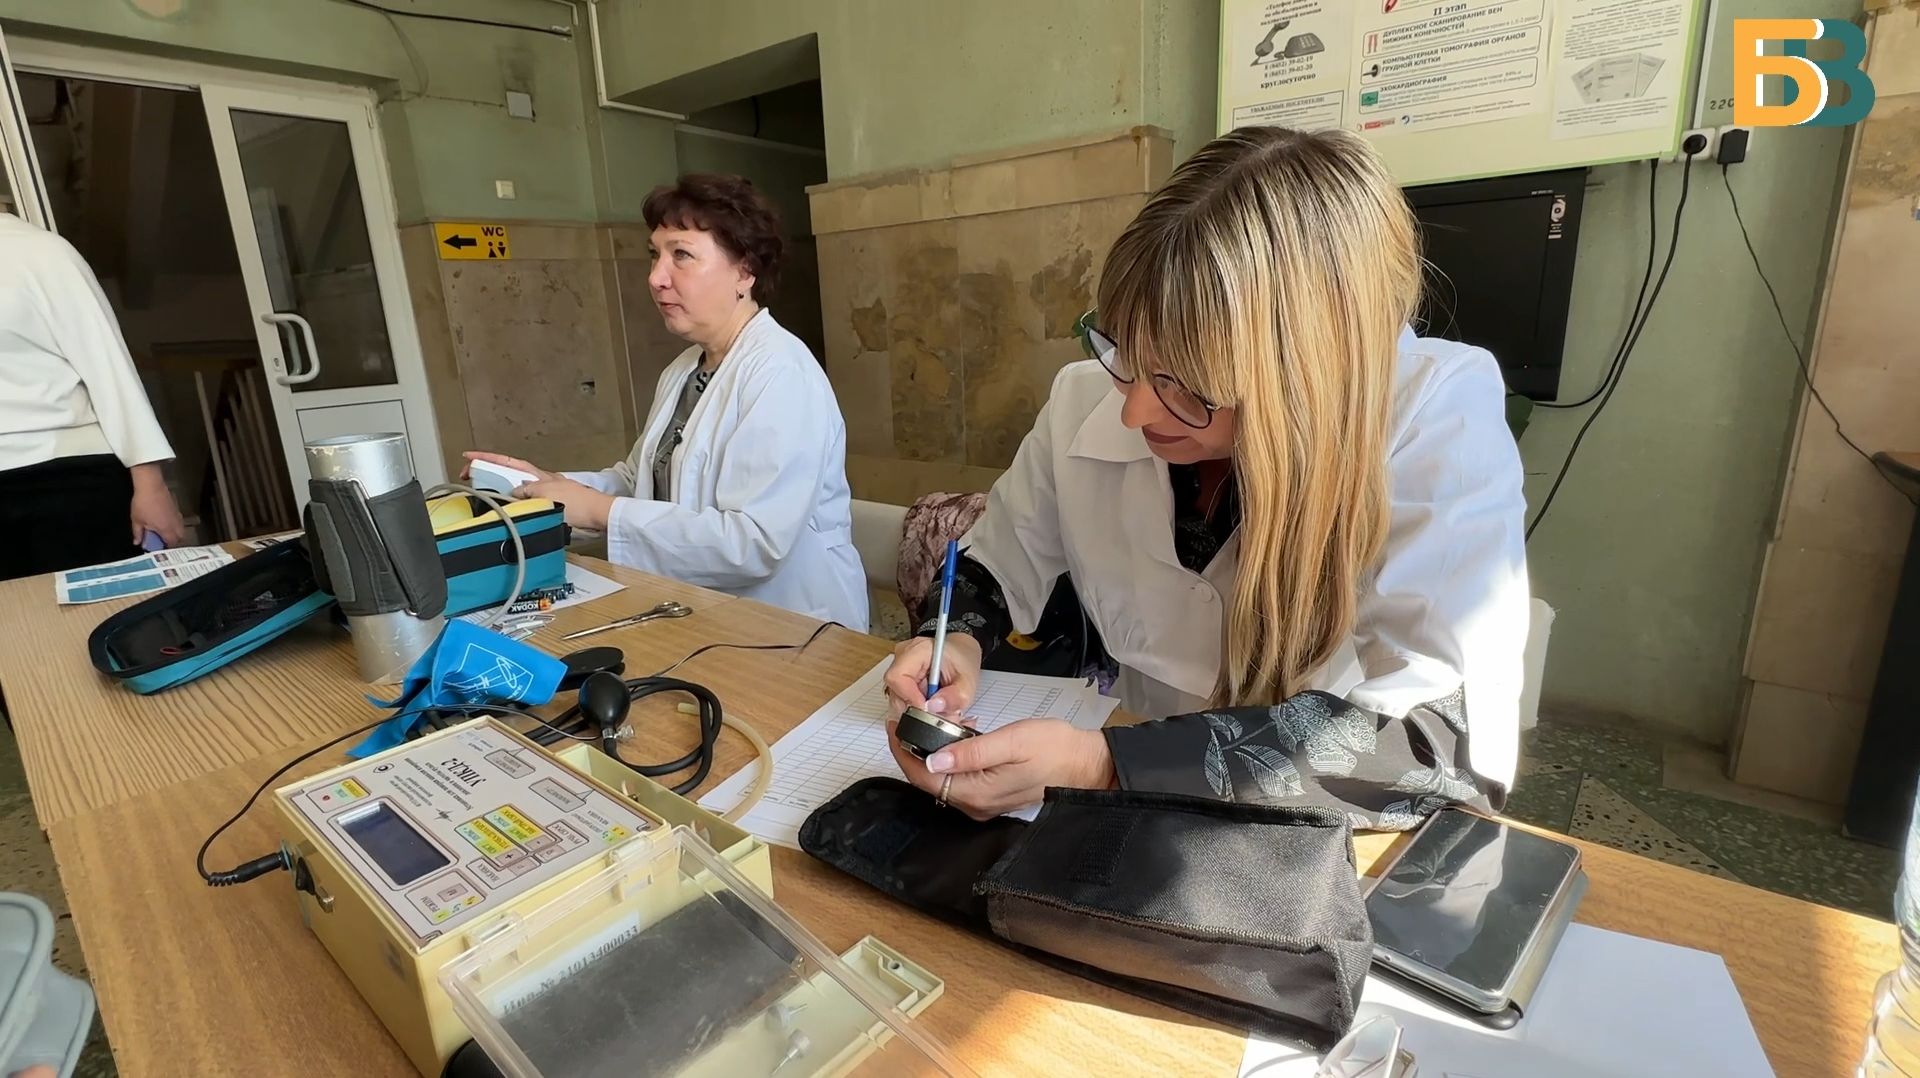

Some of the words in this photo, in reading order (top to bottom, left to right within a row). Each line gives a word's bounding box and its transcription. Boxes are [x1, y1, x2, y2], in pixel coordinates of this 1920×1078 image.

[1433, 7, 1443, 16] II
[1445, 3, 1467, 13] этап
[1383, 23, 1428, 38] ДУПЛЕКСНОЕ
[1429, 10, 1486, 27] СКАНИРОВАНИЕ
[1488, 6, 1503, 15] ВЕН
[1382, 33, 1412, 44] НИЖНИХ
[1414, 22, 1465, 37] КОНЕЧНОСТЕЙ
[1382, 49, 1439, 64] КОМПЬЮТЕРНАЯ
[1440, 38, 1490, 53] ТОМОГРАФИЯ
[1491, 32, 1526, 44] ОРГАНОВ
[1381, 61, 1413, 72] ГРУДНОЙ
[1414, 56, 1441, 66] КЛЕТКИ
[1260, 73, 1316, 89] круглосуточно
[1380, 75, 1447, 92] ЭХОКАРДИОГРАФИЯ
[481, 226, 504, 237] WC
[511, 602, 539, 613] KODAK
